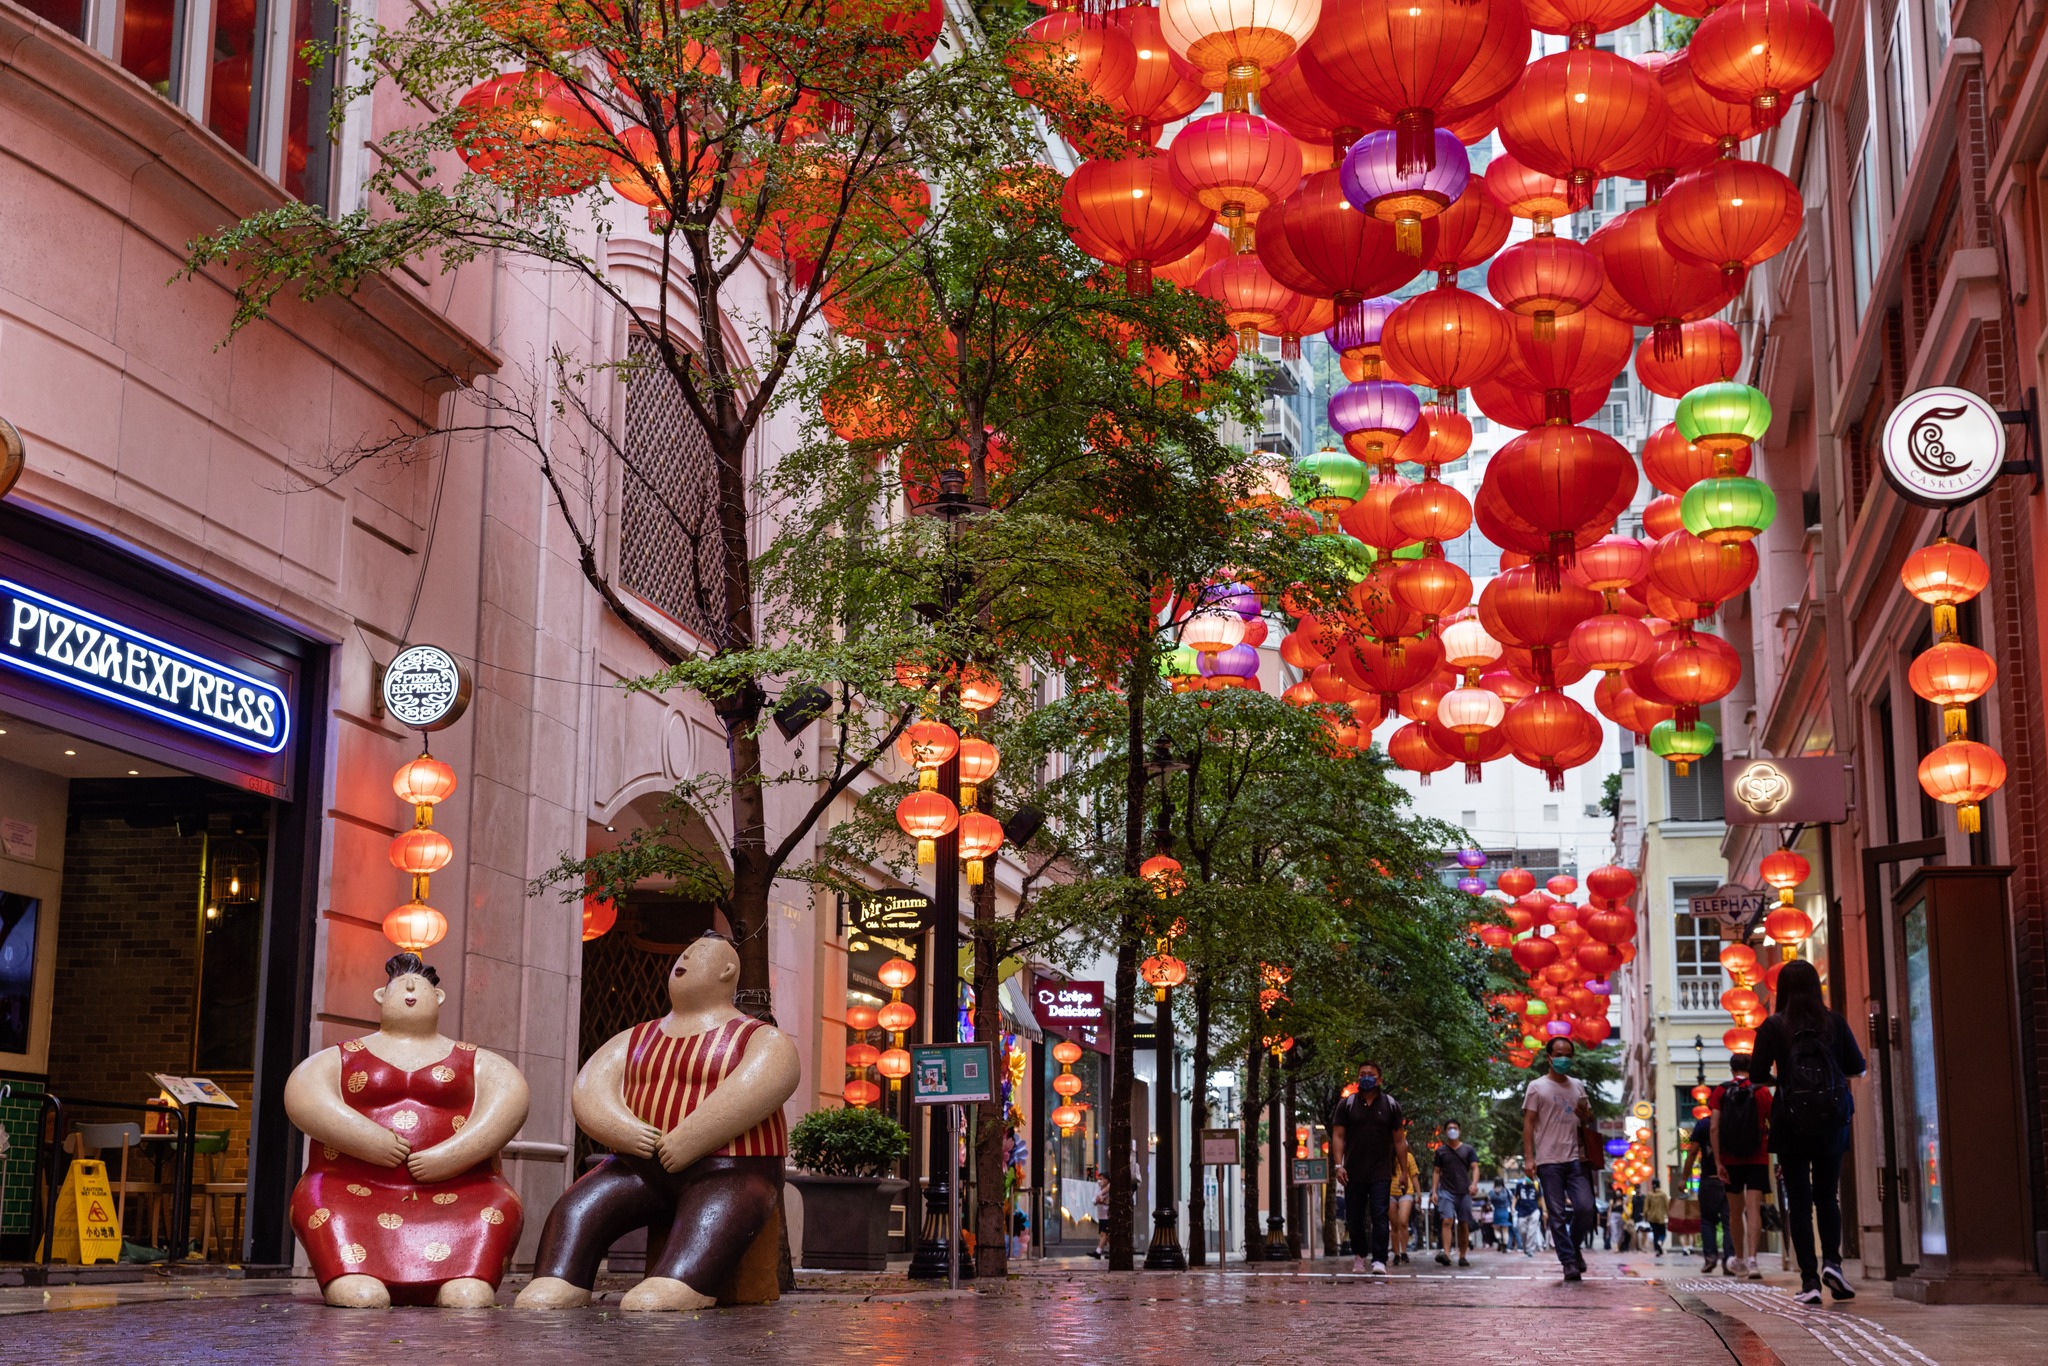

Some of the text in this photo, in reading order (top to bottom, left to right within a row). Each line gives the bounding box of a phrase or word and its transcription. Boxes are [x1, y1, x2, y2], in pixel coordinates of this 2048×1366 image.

[1910, 467, 1982, 489] CASKELLS
[9, 598, 275, 738] PIZZAEXPRESS
[402, 672, 441, 684] PIZZA
[391, 682, 451, 695] EXPRESS
[1749, 778, 1777, 800] SP
[860, 896, 928, 923] Mr Simms
[1694, 898, 1762, 913] ELEPHAN
[1048, 1003, 1102, 1018] Delicious
[86, 1226, 115, 1239] 小心地滑
